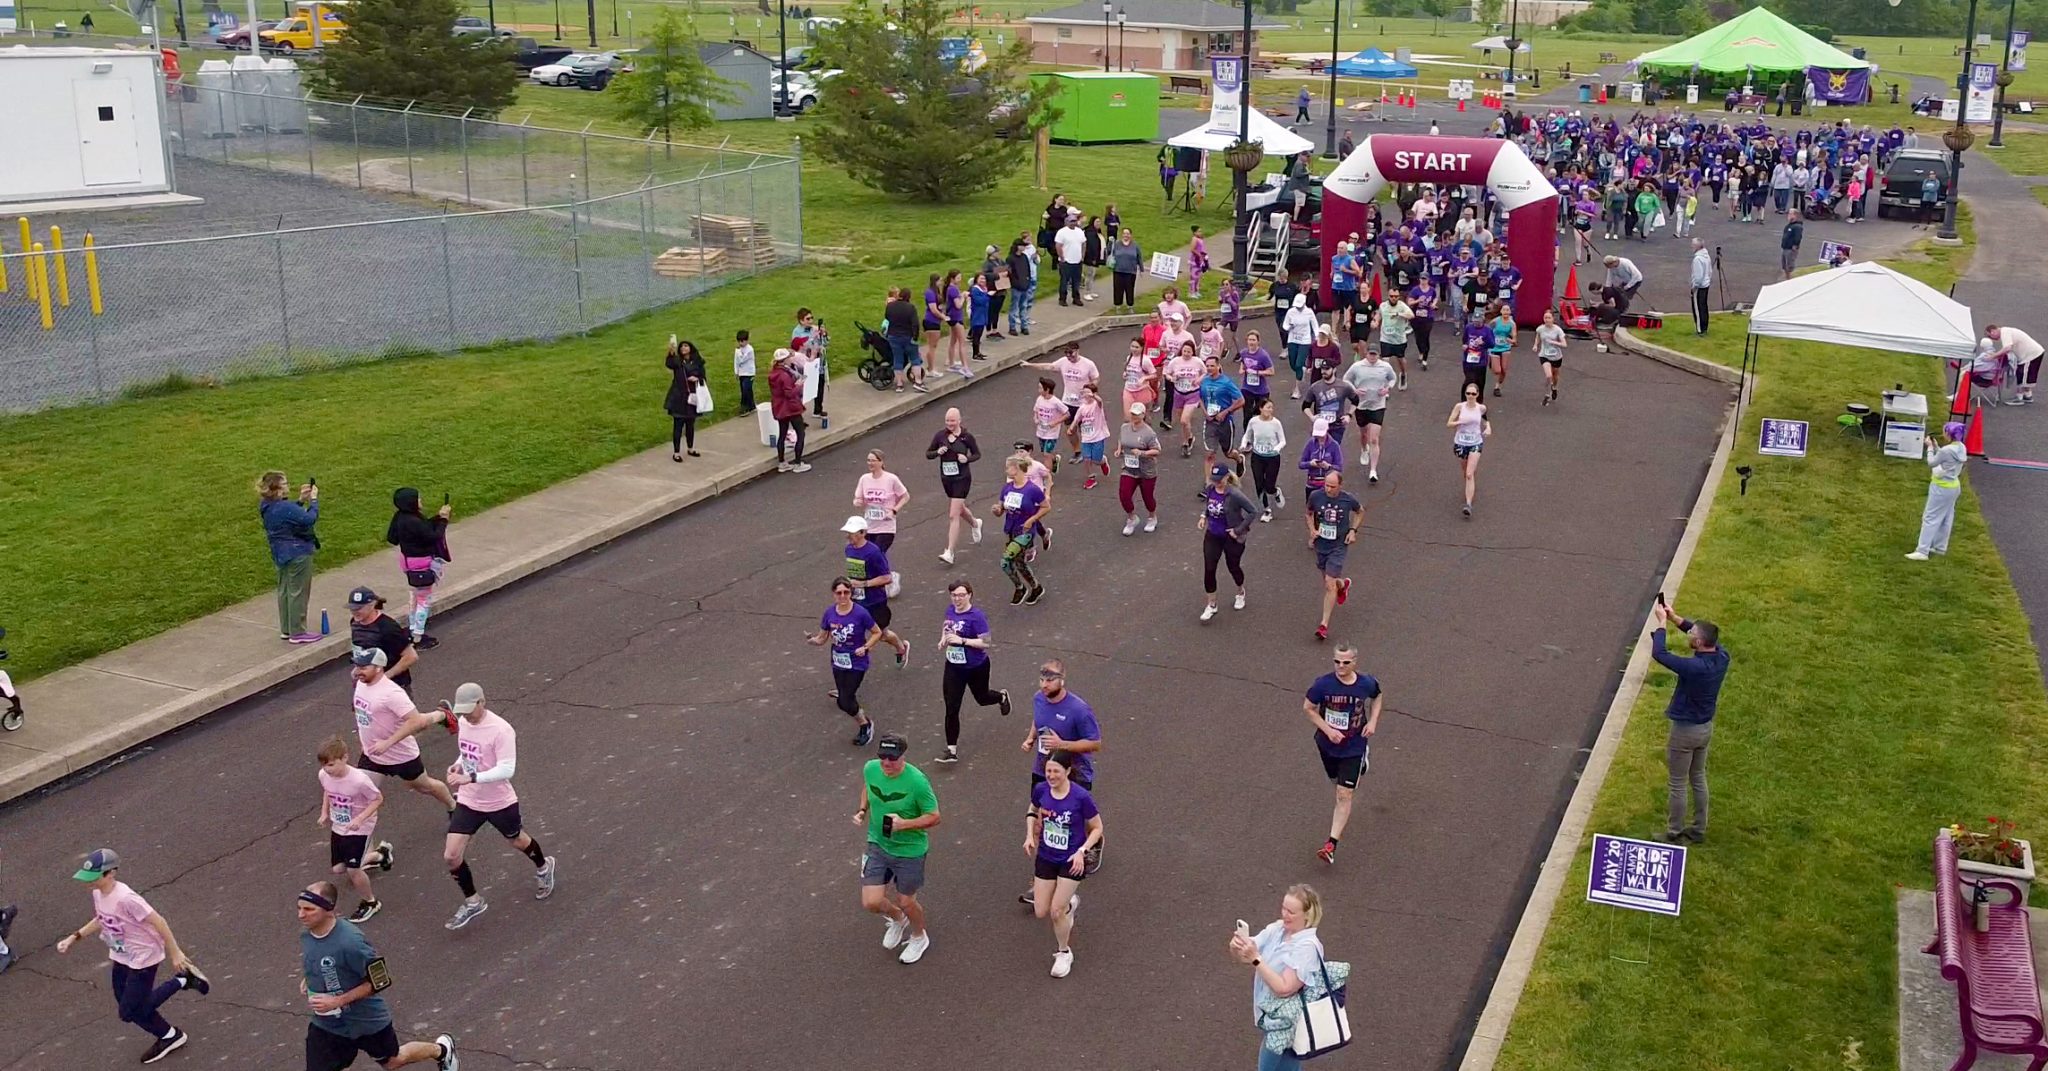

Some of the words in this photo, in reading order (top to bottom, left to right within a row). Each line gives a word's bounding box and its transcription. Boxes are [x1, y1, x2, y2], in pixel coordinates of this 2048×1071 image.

[1394, 151, 1472, 171] START
[1320, 526, 1335, 538] 1491
[947, 651, 965, 661] 1463
[1326, 714, 1347, 727] 1386
[1044, 831, 1067, 846] 1400
[1608, 840, 1621, 858] 20
[1638, 847, 1671, 865] RIDE
[1627, 846, 1638, 874] AMY'S
[1604, 859, 1619, 892] MAY
[1635, 861, 1670, 879] RUN
[1627, 873, 1667, 893] WALK
